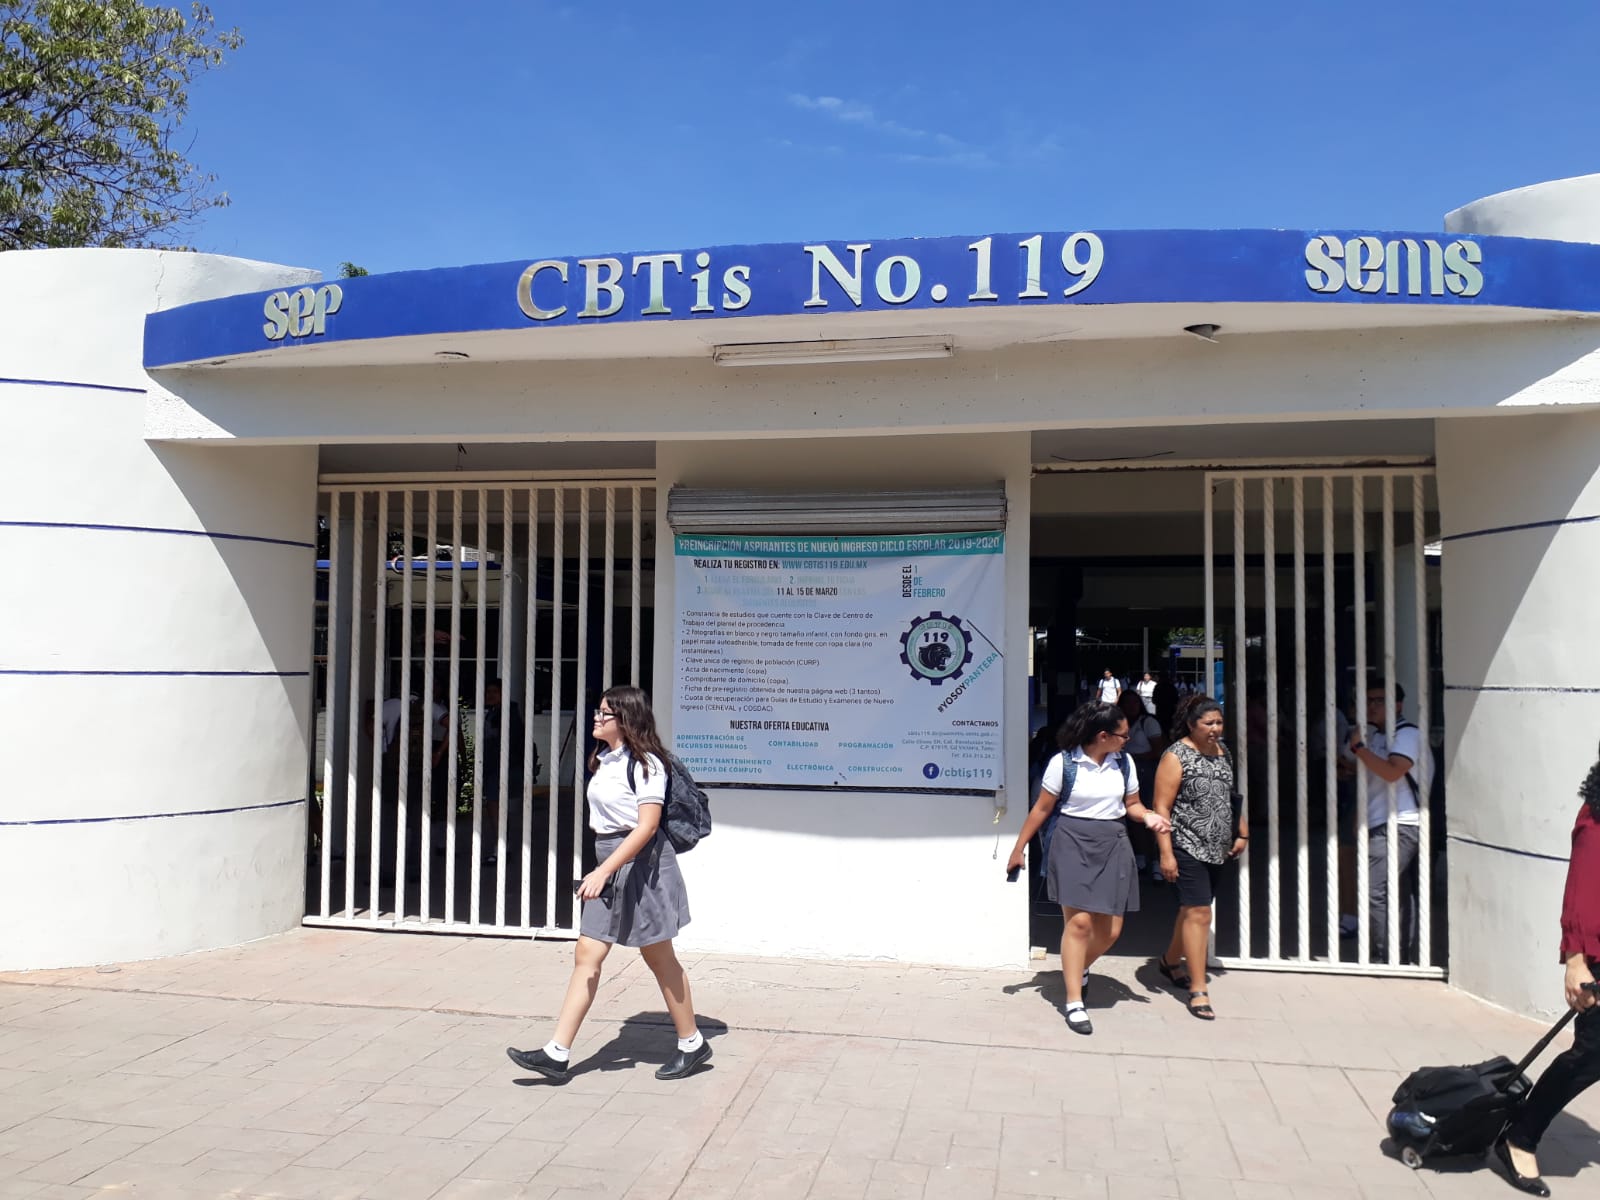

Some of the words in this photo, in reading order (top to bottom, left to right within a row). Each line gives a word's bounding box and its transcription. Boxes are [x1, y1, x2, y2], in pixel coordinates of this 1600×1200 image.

[516, 251, 752, 320] CBTis
[804, 244, 948, 307] No.
[968, 232, 1104, 299] 119
[262, 283, 343, 341] sep
[744, 540, 797, 553] ASPIRANTES
[798, 542, 809, 552] DE
[811, 542, 839, 552] NUEVO
[841, 541, 878, 552] INGRESO
[880, 540, 905, 552] CICLO
[907, 539, 946, 551] ESCOLAR
[949, 537, 999, 549] 2019-2020
[694, 558, 722, 569] REALIZA
[724, 559, 733, 569] TU
[734, 559, 768, 569] REGISTRO
[902, 564, 912, 574] EL
[902, 574, 912, 598] DESDE
[913, 577, 923, 586] DE
[777, 587, 784, 596] 11
[786, 587, 794, 596] AL
[796, 587, 804, 596] 15
[805, 587, 814, 596] DE
[815, 587, 838, 596] MARZO
[913, 588, 946, 598] FEBRERO
[923, 632, 950, 643] 119
[730, 720, 762, 730] NUESTRA
[763, 720, 790, 730] OFERTA
[792, 721, 830, 731] EDUCATIVA
[940, 767, 993, 778] /cbtis119
